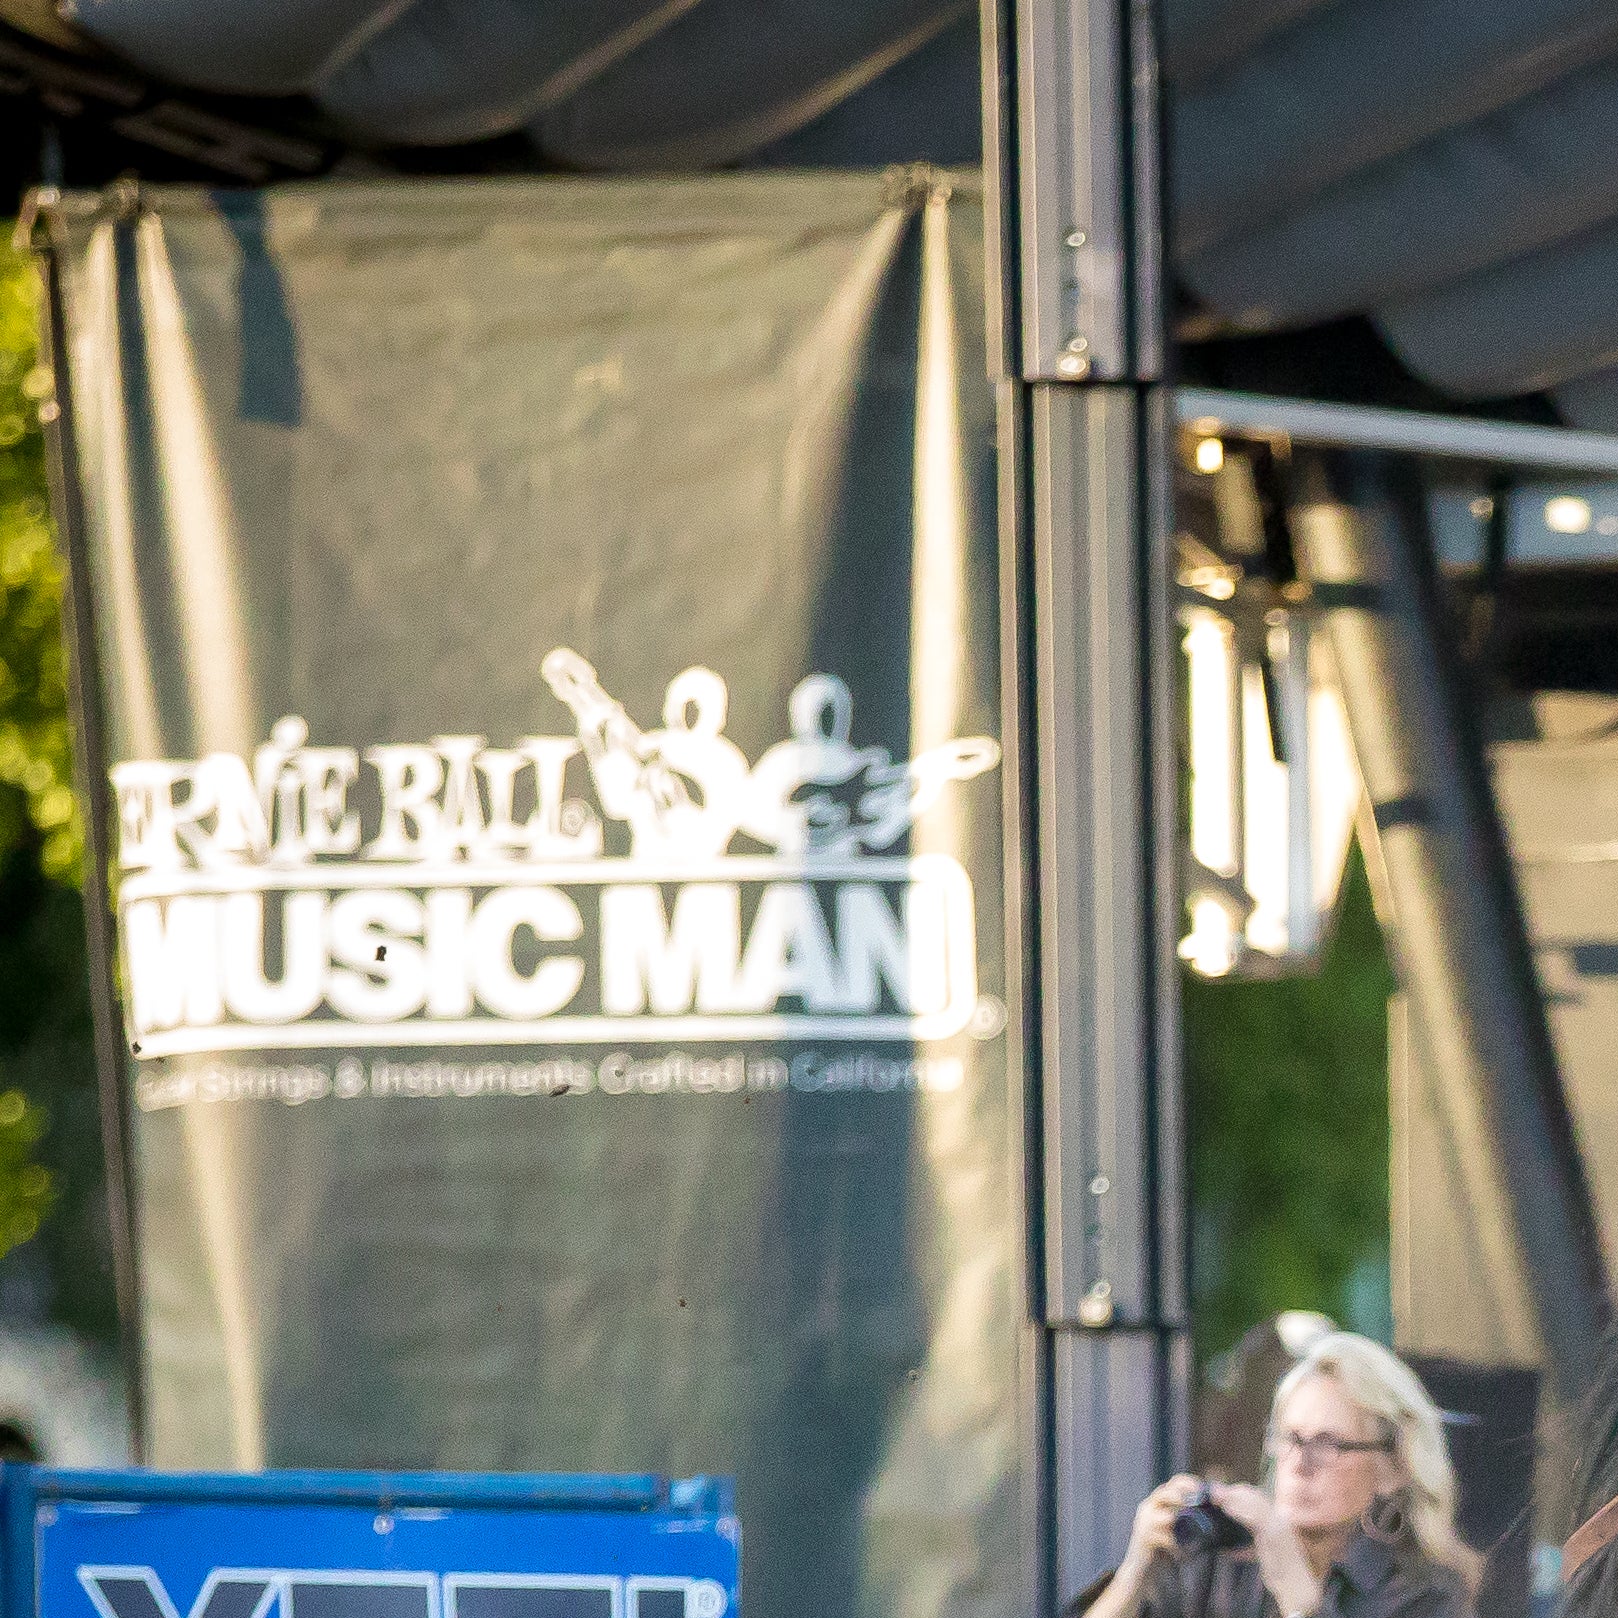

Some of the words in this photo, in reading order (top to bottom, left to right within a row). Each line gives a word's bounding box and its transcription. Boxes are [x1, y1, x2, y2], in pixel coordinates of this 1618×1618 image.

[364, 734, 604, 862] BALL
[128, 884, 585, 1032] MUSIC
[602, 880, 932, 1016] MAN
